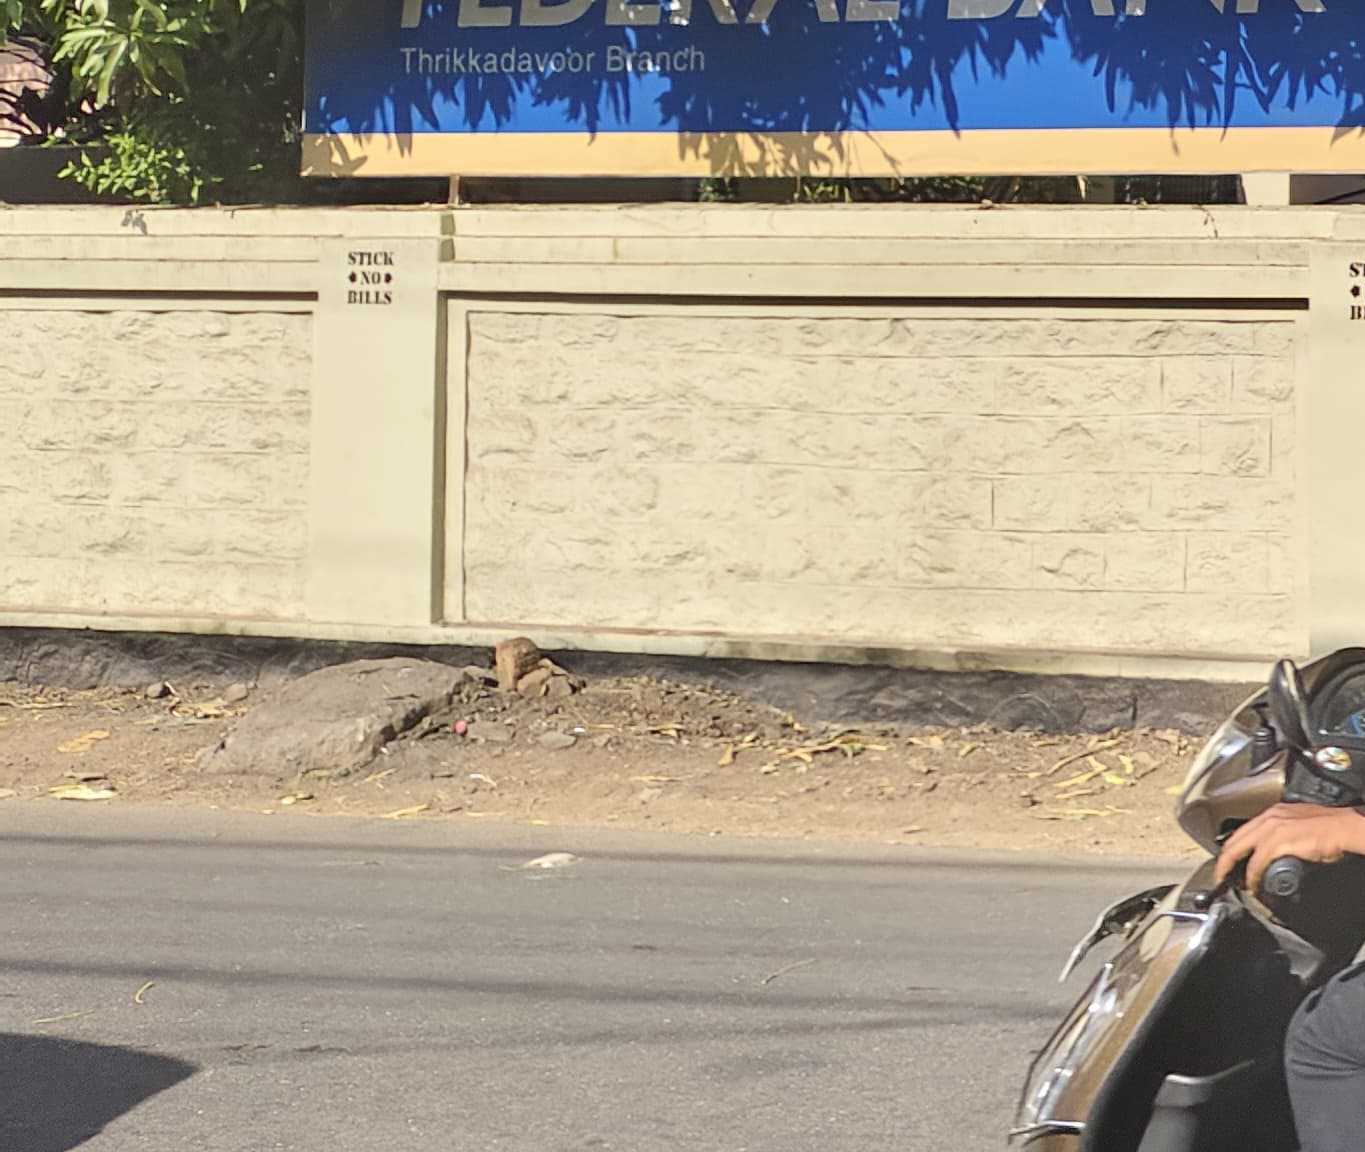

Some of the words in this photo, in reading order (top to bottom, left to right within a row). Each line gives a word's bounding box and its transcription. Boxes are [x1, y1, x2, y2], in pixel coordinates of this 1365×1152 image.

[400, 45, 595, 74] Thrikkadavoor
[606, 45, 705, 73] Branch
[347, 250, 395, 266] STICK
[360, 270, 381, 285] NO
[347, 290, 393, 305] BILLS
